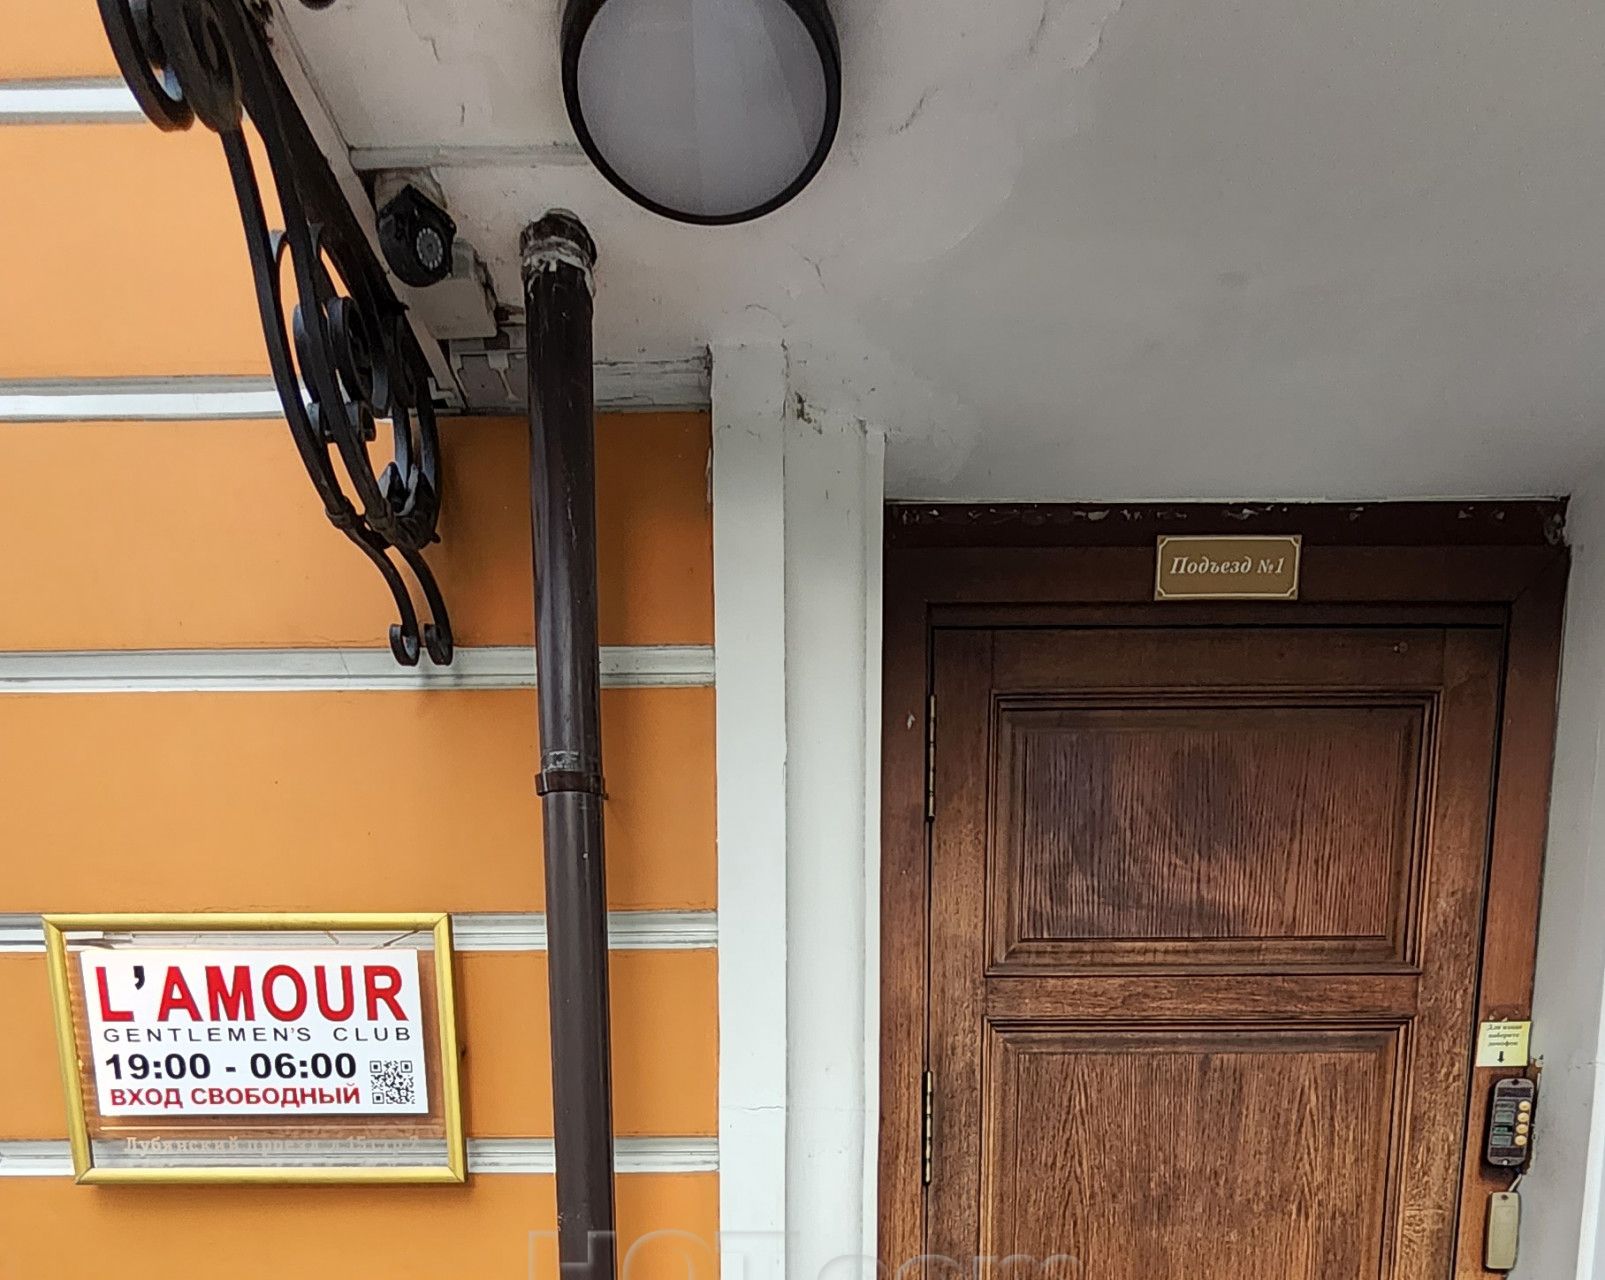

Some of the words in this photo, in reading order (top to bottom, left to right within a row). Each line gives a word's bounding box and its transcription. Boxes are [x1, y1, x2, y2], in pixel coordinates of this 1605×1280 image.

[1170, 556, 1252, 574] Подъезд
[96, 965, 408, 1022] L'AMOUR
[104, 1028, 311, 1042] GENTLEMEN'S
[333, 1027, 411, 1041] CLUB
[106, 1053, 211, 1079] 19:00
[250, 1053, 356, 1079] 06:00
[110, 1088, 183, 1108] ВХОД
[191, 1084, 361, 1108] СВОБОДНЫЙ
